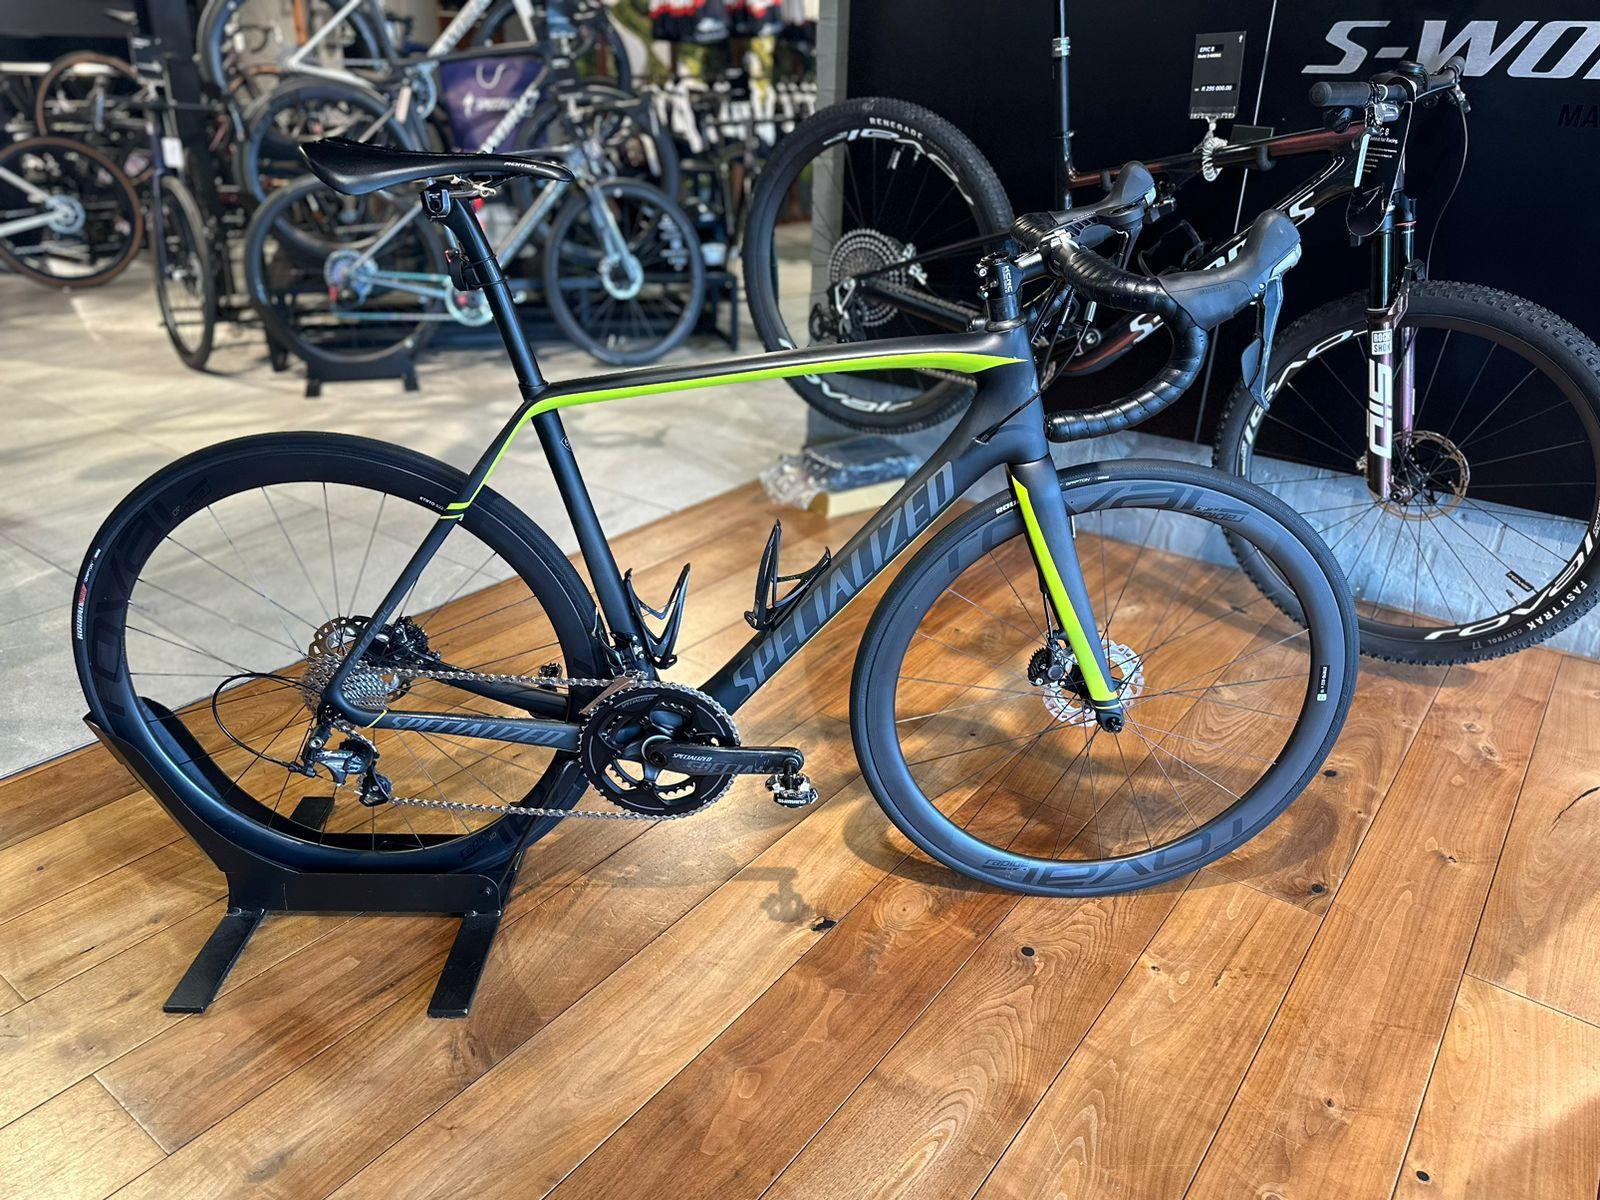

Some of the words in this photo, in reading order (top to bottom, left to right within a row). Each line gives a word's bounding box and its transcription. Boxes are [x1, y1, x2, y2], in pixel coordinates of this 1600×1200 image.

[1301, 20, 1600, 80] S-WO
[869, 117, 923, 140] RENEGADE
[1369, 358, 1393, 459] SID
[996, 499, 1019, 515] ROU
[733, 461, 954, 704] SPECIALIZED
[1561, 581, 1589, 609] FAST
[1527, 607, 1561, 631] TRAK
[391, 716, 567, 745] SPECIALIZED
[672, 752, 712, 763] SPECIALIZED
